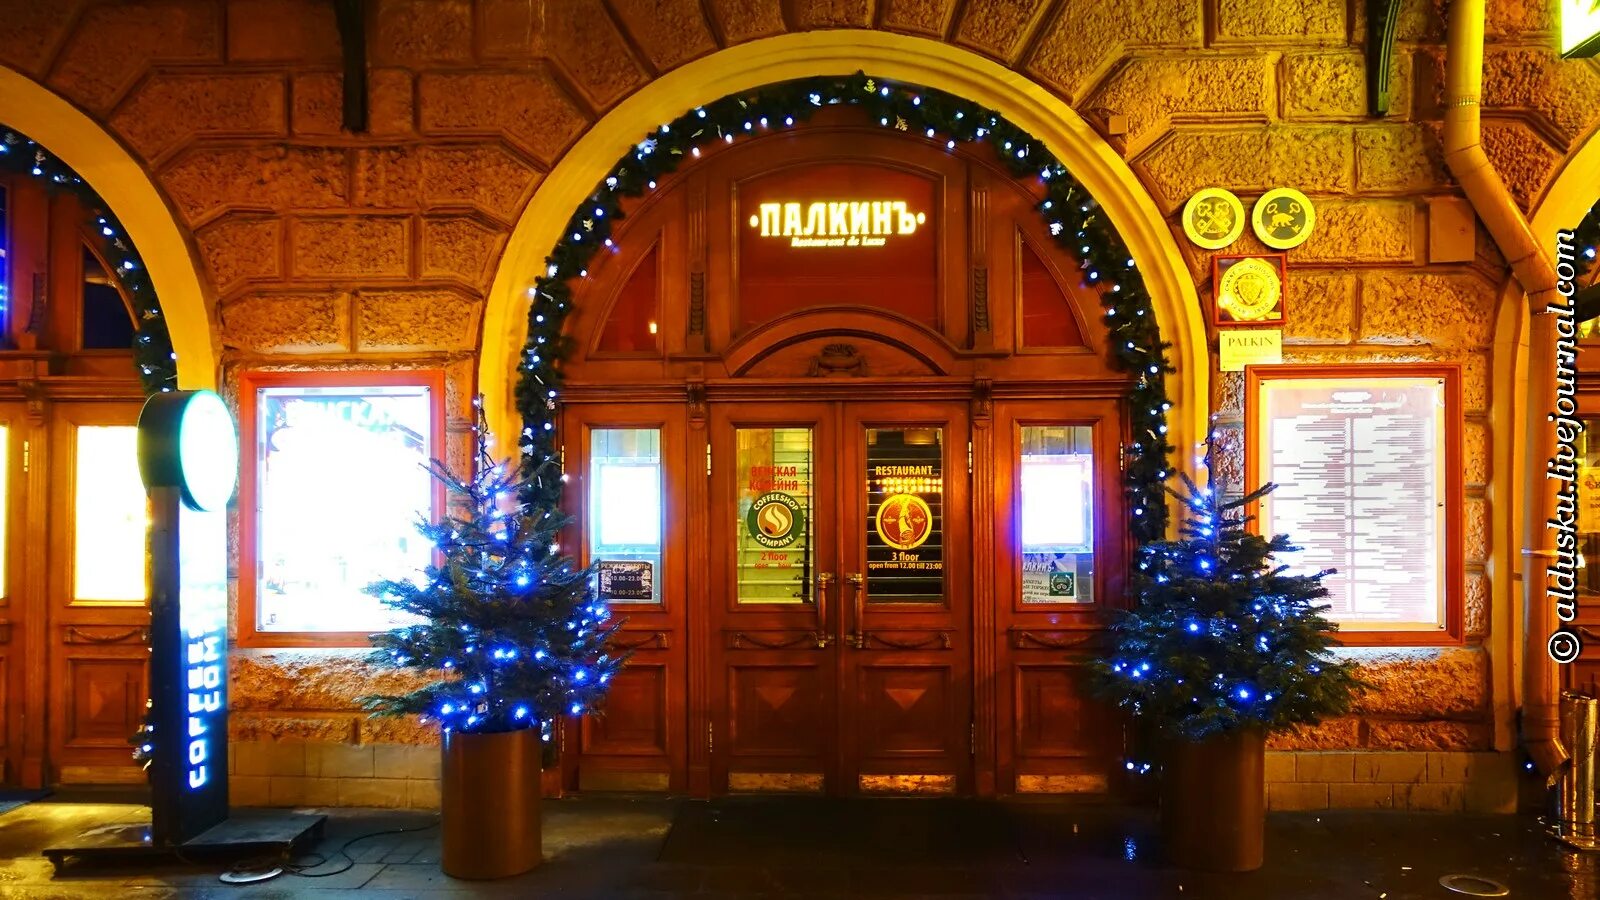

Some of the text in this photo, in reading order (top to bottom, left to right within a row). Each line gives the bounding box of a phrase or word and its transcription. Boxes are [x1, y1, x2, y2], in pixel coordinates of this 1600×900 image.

[760, 201, 917, 236] ПАЛКИНЪ
[1228, 337, 1273, 347] PALKIN
[875, 465, 933, 476] RESTAURANT
[753, 493, 799, 511] COFFEESHOP
[756, 533, 794, 547] COMPANY
[761, 551, 788, 561] 2 floor
[892, 552, 920, 561] 3 floor
